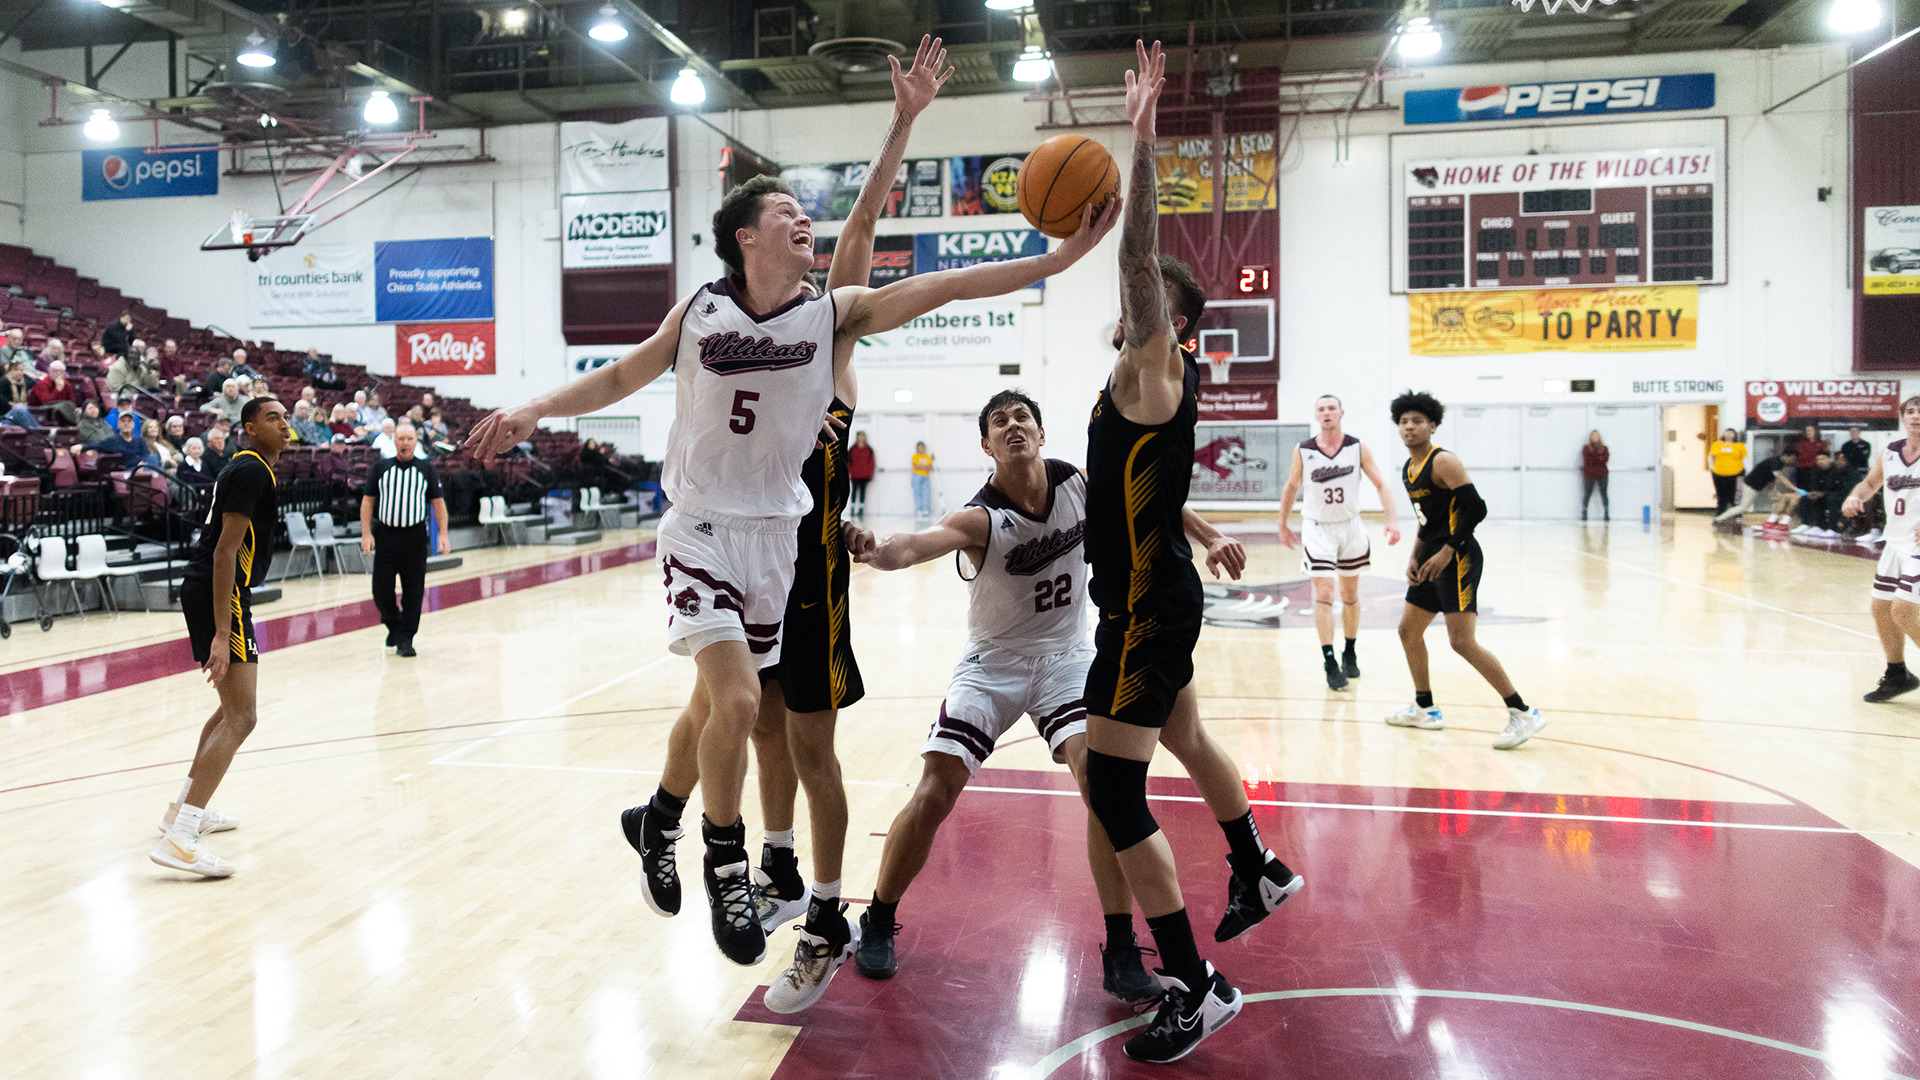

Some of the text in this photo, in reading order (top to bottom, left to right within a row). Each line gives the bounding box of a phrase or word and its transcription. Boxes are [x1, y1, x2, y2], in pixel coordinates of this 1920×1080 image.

[1504, 77, 1661, 114] PEPSI
[135, 153, 201, 185] pepsi
[1443, 154, 1711, 186] HOME OF THE WILDCATS!
[568, 210, 667, 241] MODERN
[1481, 217, 1513, 229] CHICO
[1600, 211, 1636, 225] GUEST
[938, 231, 1030, 256] KPAY
[258, 270, 363, 286] tri counties bank
[389, 265, 479, 280] Proudly supporting
[1239, 268, 1269, 292] 21
[386, 278, 482, 293] Chico State Athletics
[902, 311, 1015, 330] mbers 1st
[1539, 311, 1573, 341] TO
[1586, 308, 1683, 340] PARTY
[698, 331, 817, 366] Wildcats
[906, 334, 992, 346] Credit Union
[408, 332, 486, 370] Raley's
[1632, 379, 1725, 394] BUTTE STRONG
[1748, 380, 1897, 397] GO WILDCATS!
[729, 389, 761, 435] 5
[1215, 480, 1263, 493] STATE
[1323, 486, 1345, 504] 33
[1894, 497, 1905, 516] 0
[694, 525, 714, 537] adidas
[1034, 573, 1072, 613] 22
